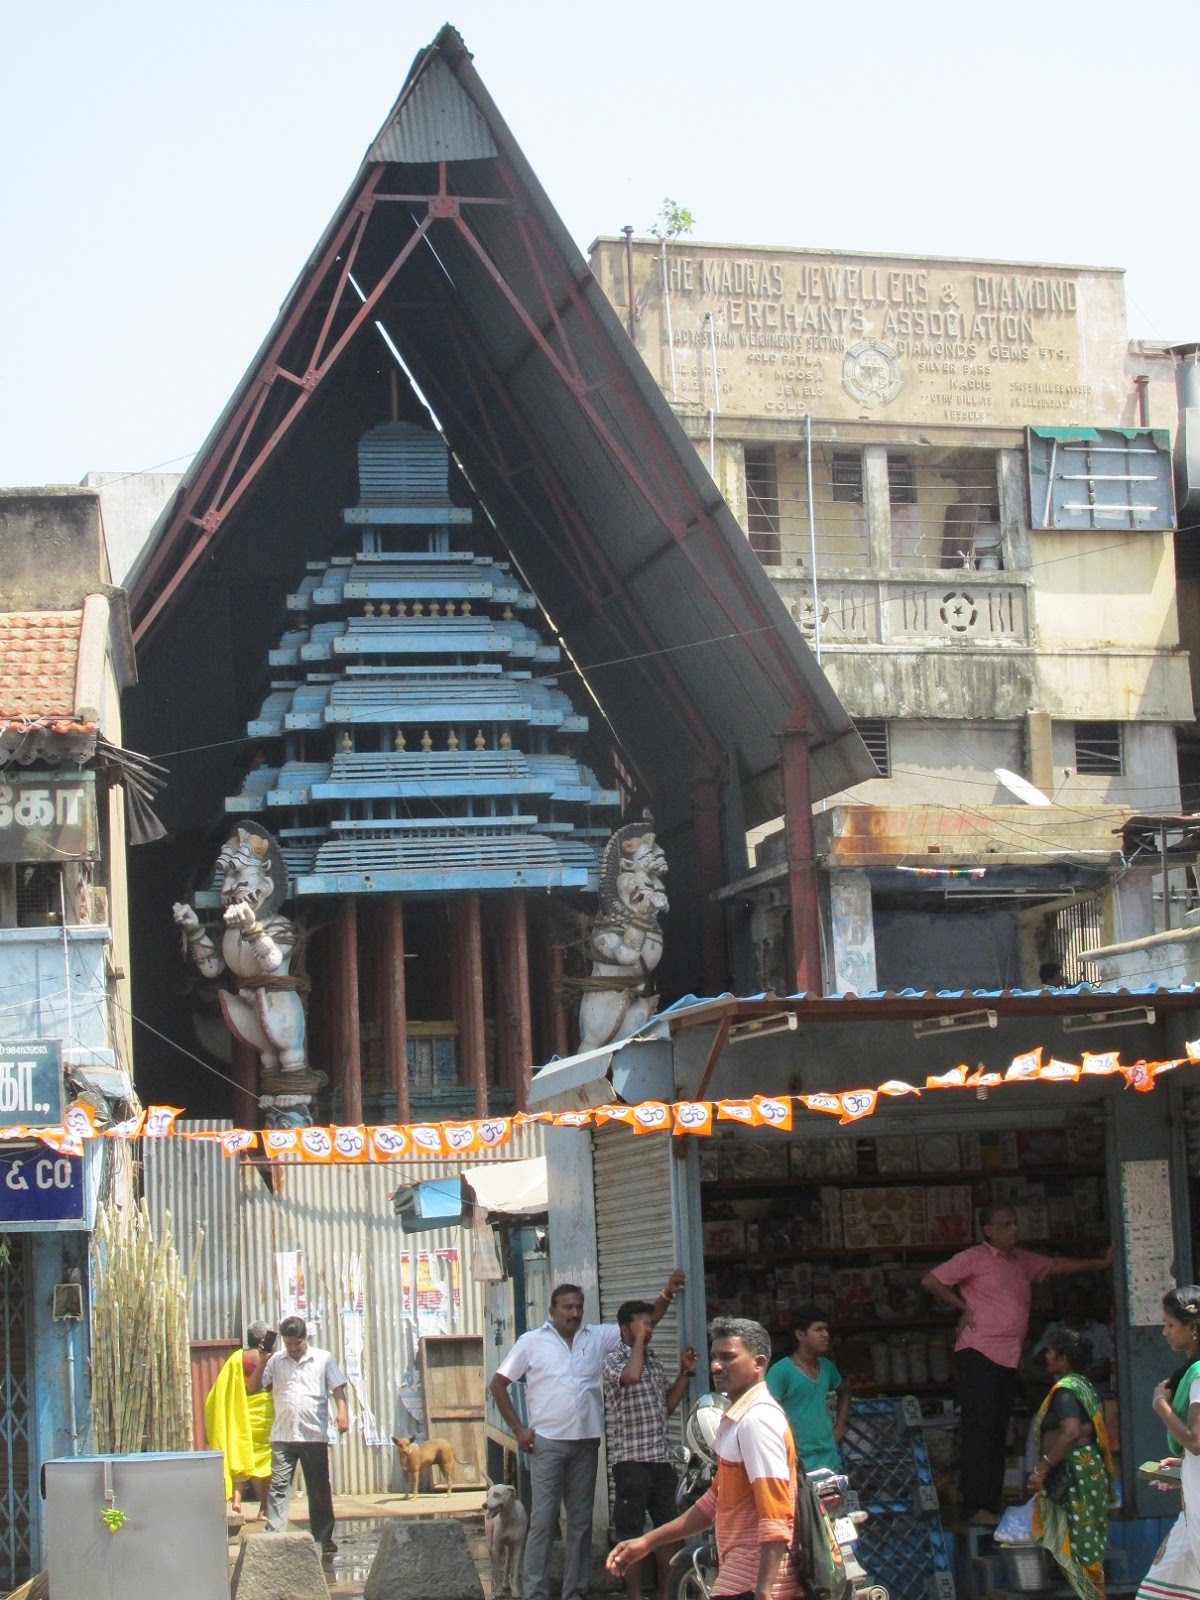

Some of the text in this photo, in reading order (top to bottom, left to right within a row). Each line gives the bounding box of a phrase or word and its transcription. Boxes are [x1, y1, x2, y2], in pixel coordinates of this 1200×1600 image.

[702, 259, 784, 296] MADRAS
[798, 265, 928, 303] JEWELLERS
[939, 282, 959, 307] &
[975, 275, 1077, 310] DIAMOND
[882, 309, 1033, 341] ASSOCIATION
[807, 335, 845, 350] SECTION
[897, 340, 977, 357] DIAMONDS
[989, 345, 1029, 359] GEMS
[918, 361, 992, 375] SILVER BARS
[777, 386, 825, 397] JEWELS
[765, 401, 806, 411] GOLD
[6, 1158, 75, 1190] & CO.
